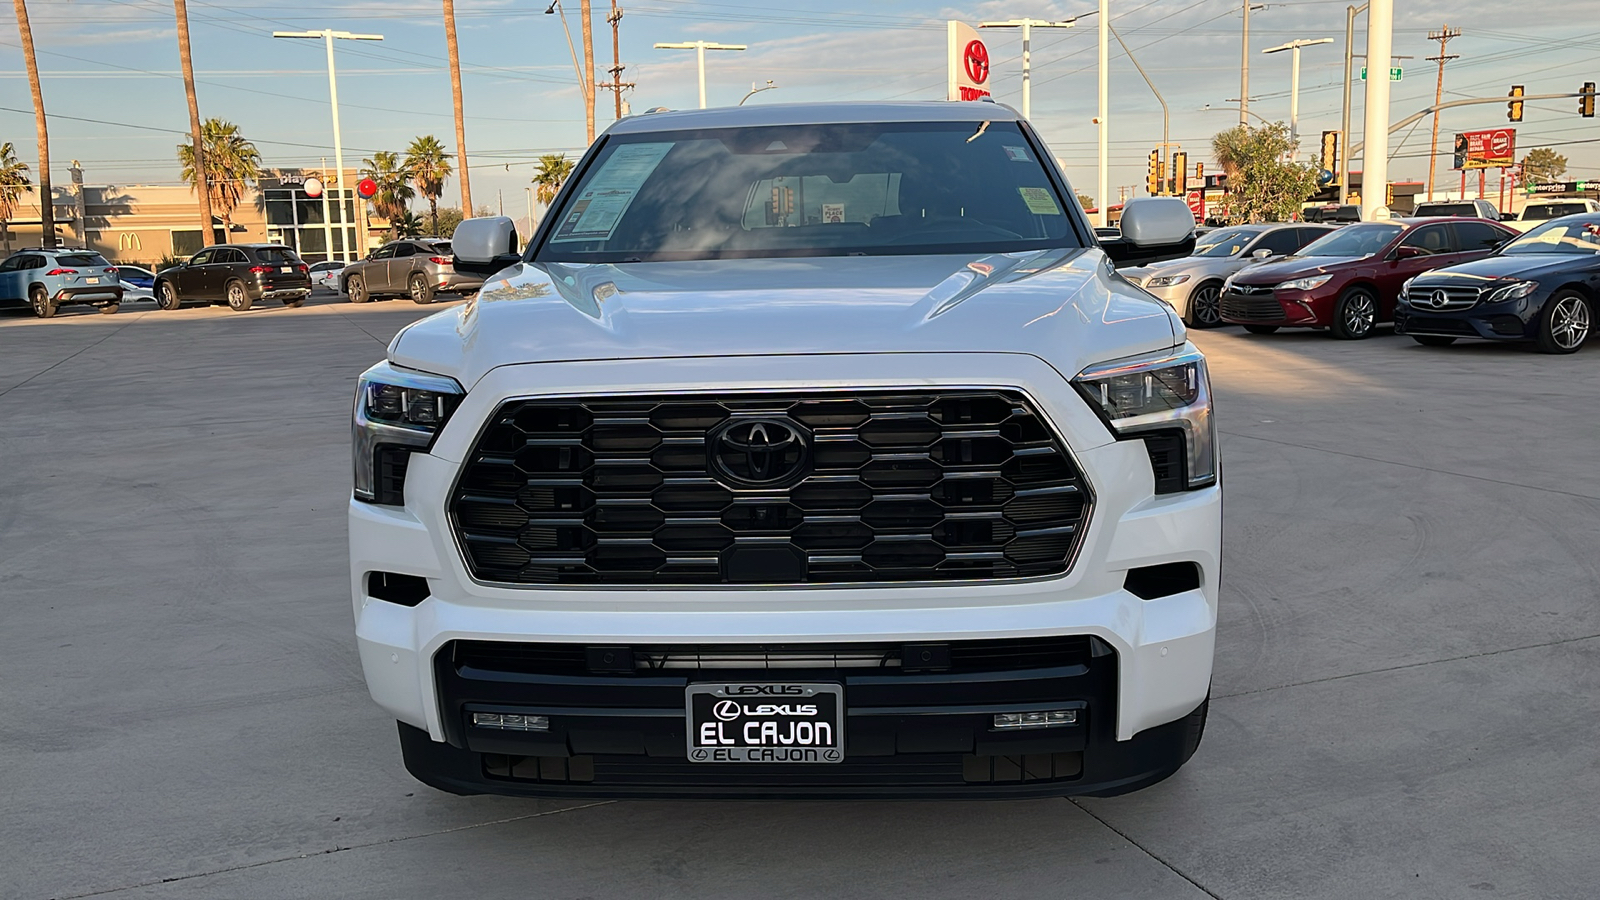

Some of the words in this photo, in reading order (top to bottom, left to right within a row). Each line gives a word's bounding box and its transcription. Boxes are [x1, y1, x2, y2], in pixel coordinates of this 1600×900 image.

[280, 171, 306, 186] play
[725, 686, 803, 695] LEXUS
[743, 705, 818, 716] LEXUS
[700, 721, 735, 745] EL
[743, 721, 832, 745] CAJON
[713, 749, 740, 761] EL
[747, 749, 818, 761] CAJON
